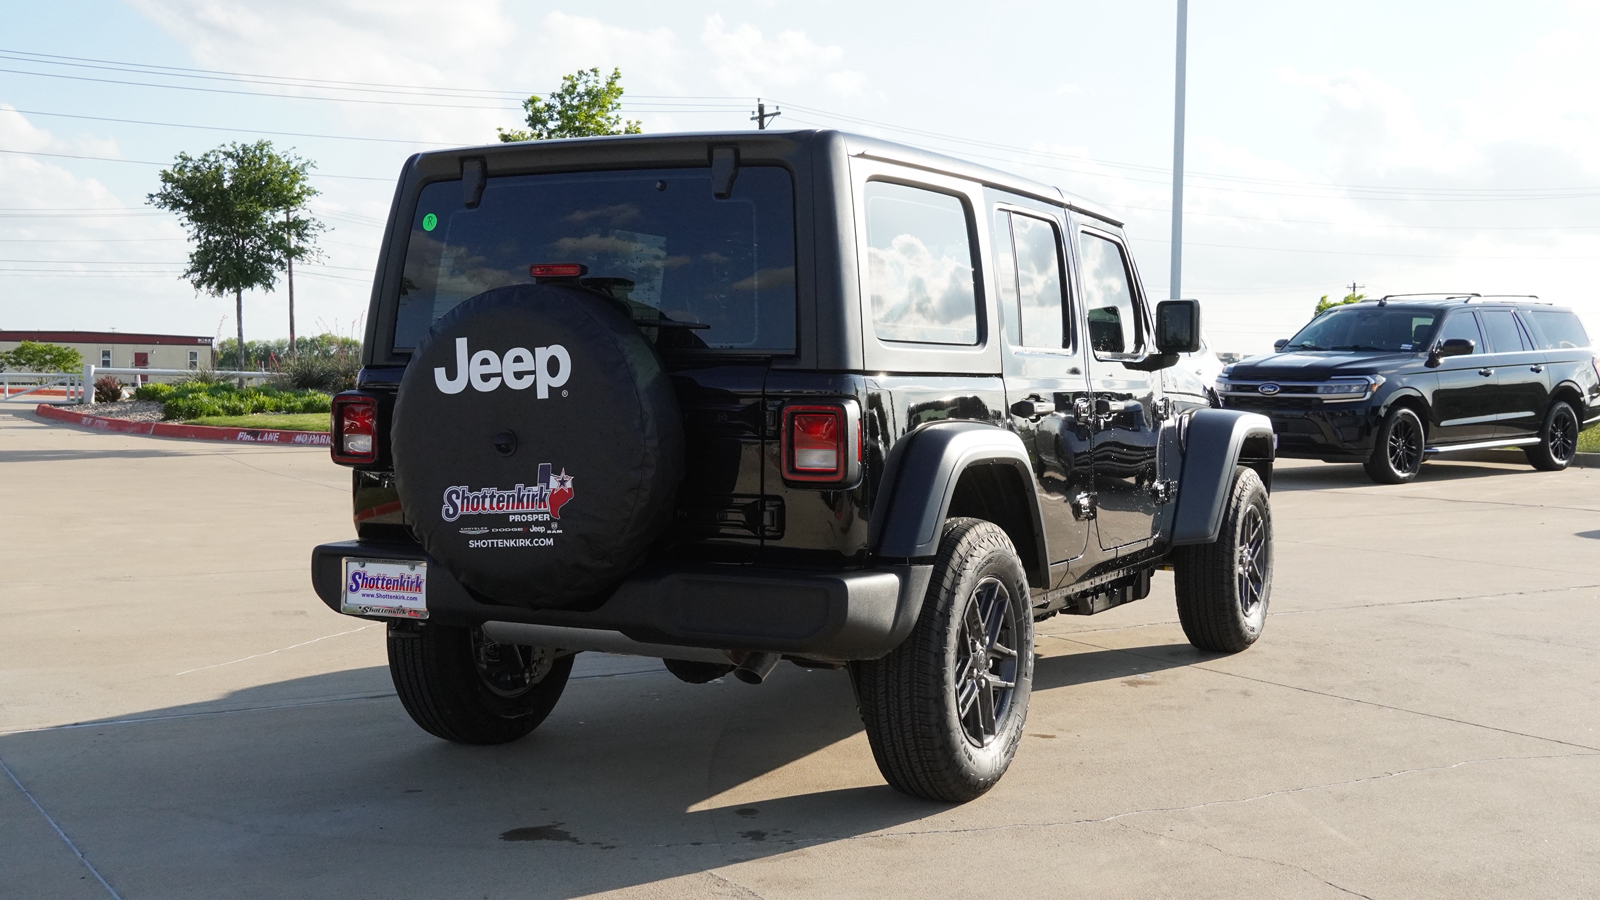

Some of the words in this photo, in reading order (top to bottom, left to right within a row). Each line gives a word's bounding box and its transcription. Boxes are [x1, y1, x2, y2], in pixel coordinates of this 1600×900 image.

[434, 337, 571, 399] Jeep
[257, 432, 280, 442] LANE
[294, 434, 308, 444] NO
[442, 483, 552, 522] Shottenkirk
[509, 513, 551, 522] PROSPER
[529, 524, 546, 534] Jeep
[468, 538, 554, 549] SHOTTENKIRK.COM
[349, 570, 424, 594] Shottenkirk
[361, 593, 418, 601] www.Shottenkirk.com
